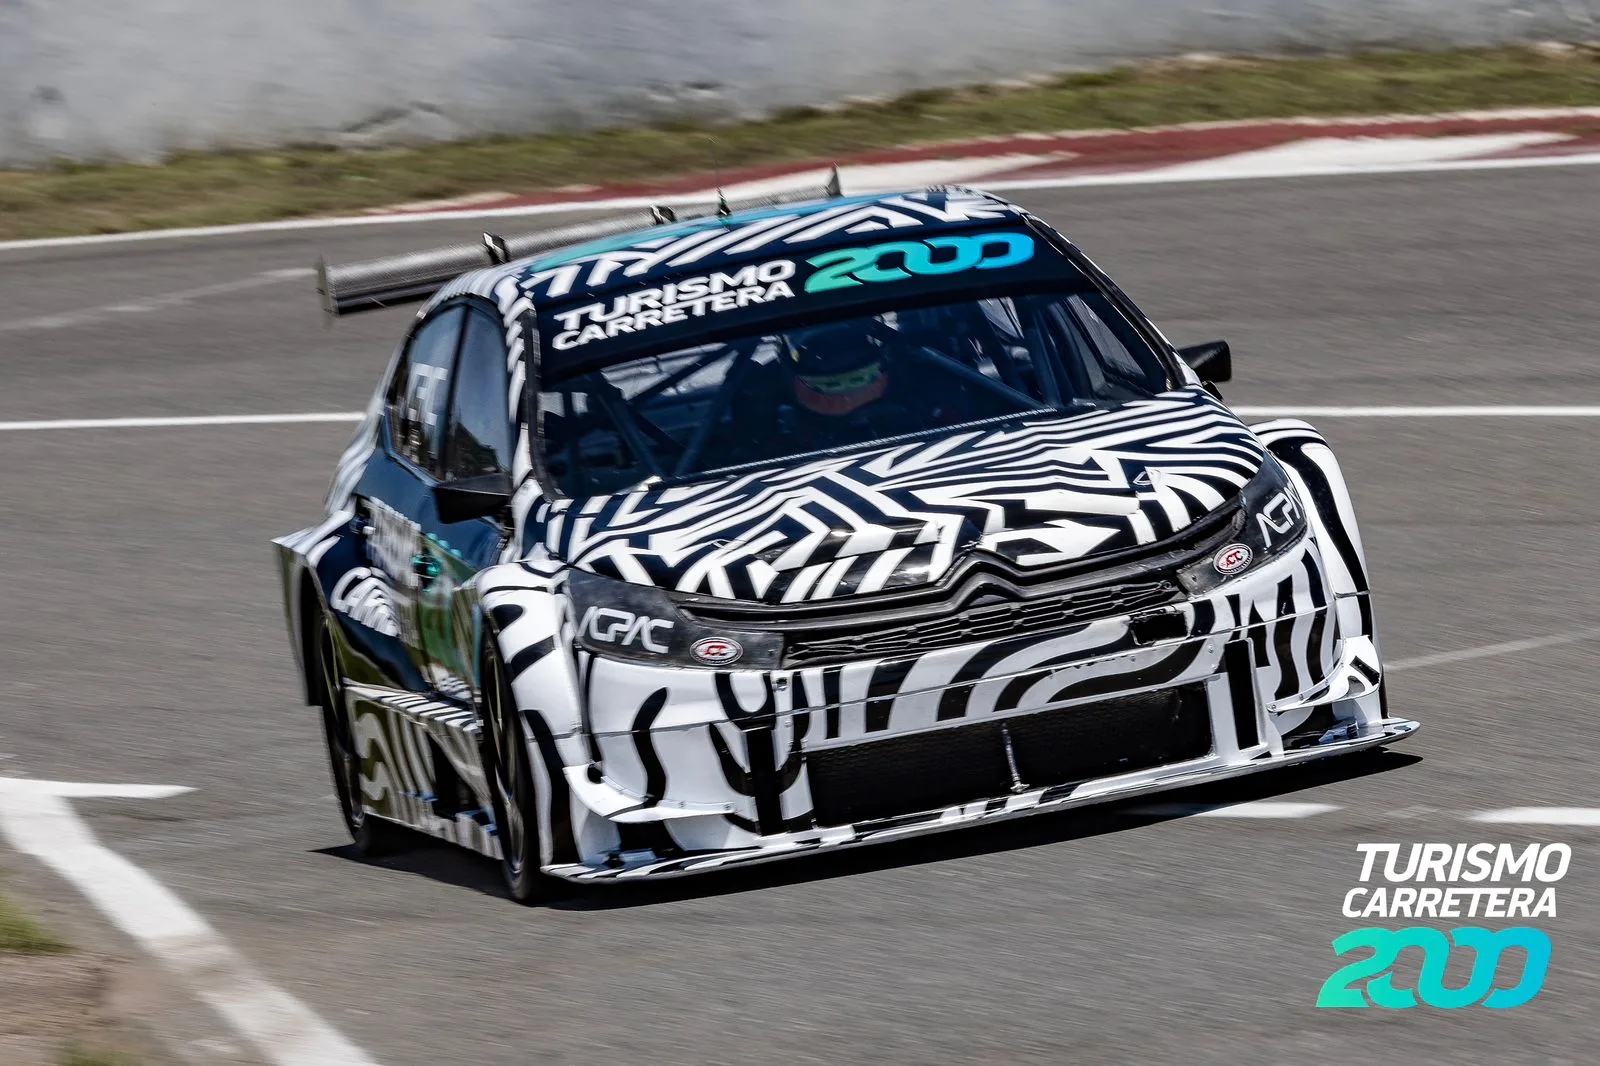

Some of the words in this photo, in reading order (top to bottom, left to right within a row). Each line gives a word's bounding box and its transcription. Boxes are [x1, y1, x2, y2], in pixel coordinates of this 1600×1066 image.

[554, 259, 796, 331] TURISMO
[804, 232, 1035, 293] 2000
[552, 281, 795, 350] CARRETERA
